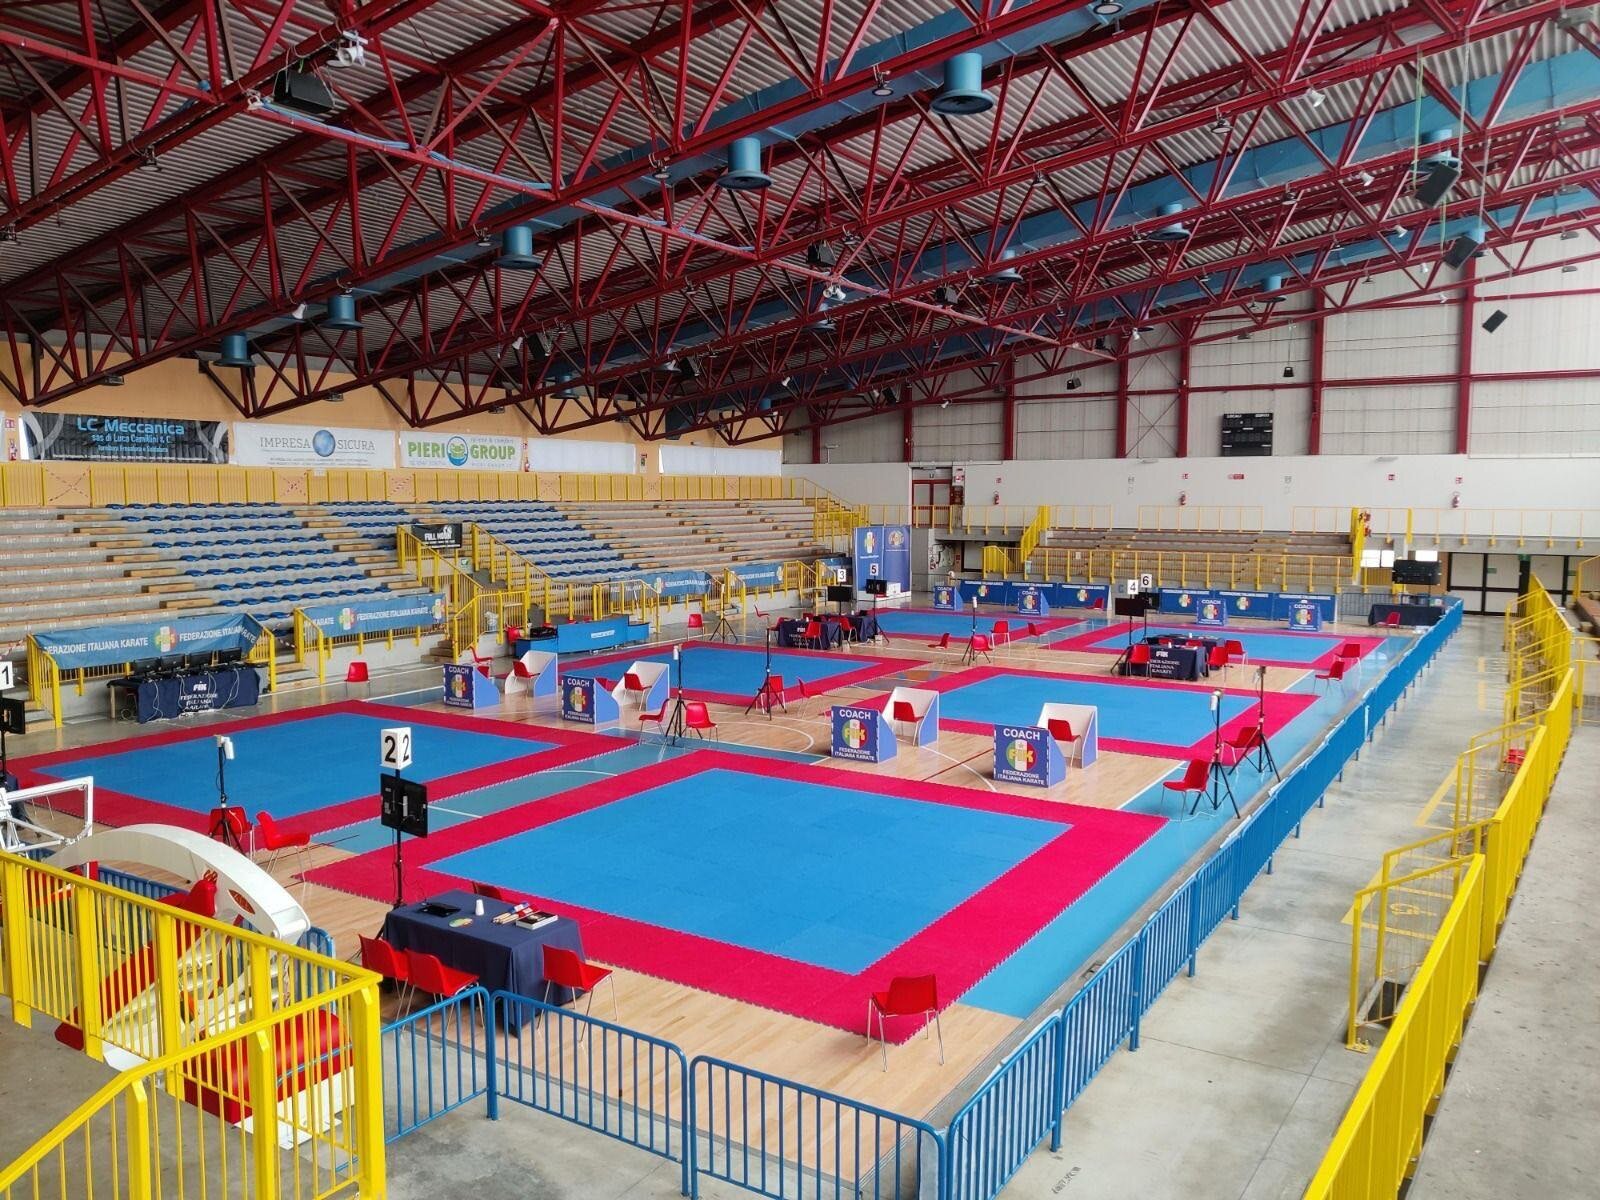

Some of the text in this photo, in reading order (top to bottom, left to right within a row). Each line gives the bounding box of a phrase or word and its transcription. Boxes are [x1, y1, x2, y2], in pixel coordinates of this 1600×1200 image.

[77, 417, 185, 435] LC Meccanica
[260, 437, 375, 451] IMPRESA SICURA
[408, 441, 516, 460] PIERI GROUP
[839, 570, 846, 580] 3
[871, 565, 877, 575] 5
[1130, 581, 1137, 592] 4
[1142, 575, 1150, 586] 6
[179, 628, 222, 642] FEDERAZIONE
[87, 640, 119, 652] ITALIANA
[120, 637, 149, 649] KARATE
[2, 665, 9, 685] 1
[448, 665, 469, 674] COACH
[567, 677, 590, 687] COACH
[839, 708, 871, 720] COACH
[1003, 727, 1040, 741] COACH
[384, 735, 396, 764] 2
[402, 734, 410, 763] 2
[997, 773, 1045, 785] ITALIANA KARATE
[1002, 769, 1040, 780] FEDERAZIONE
